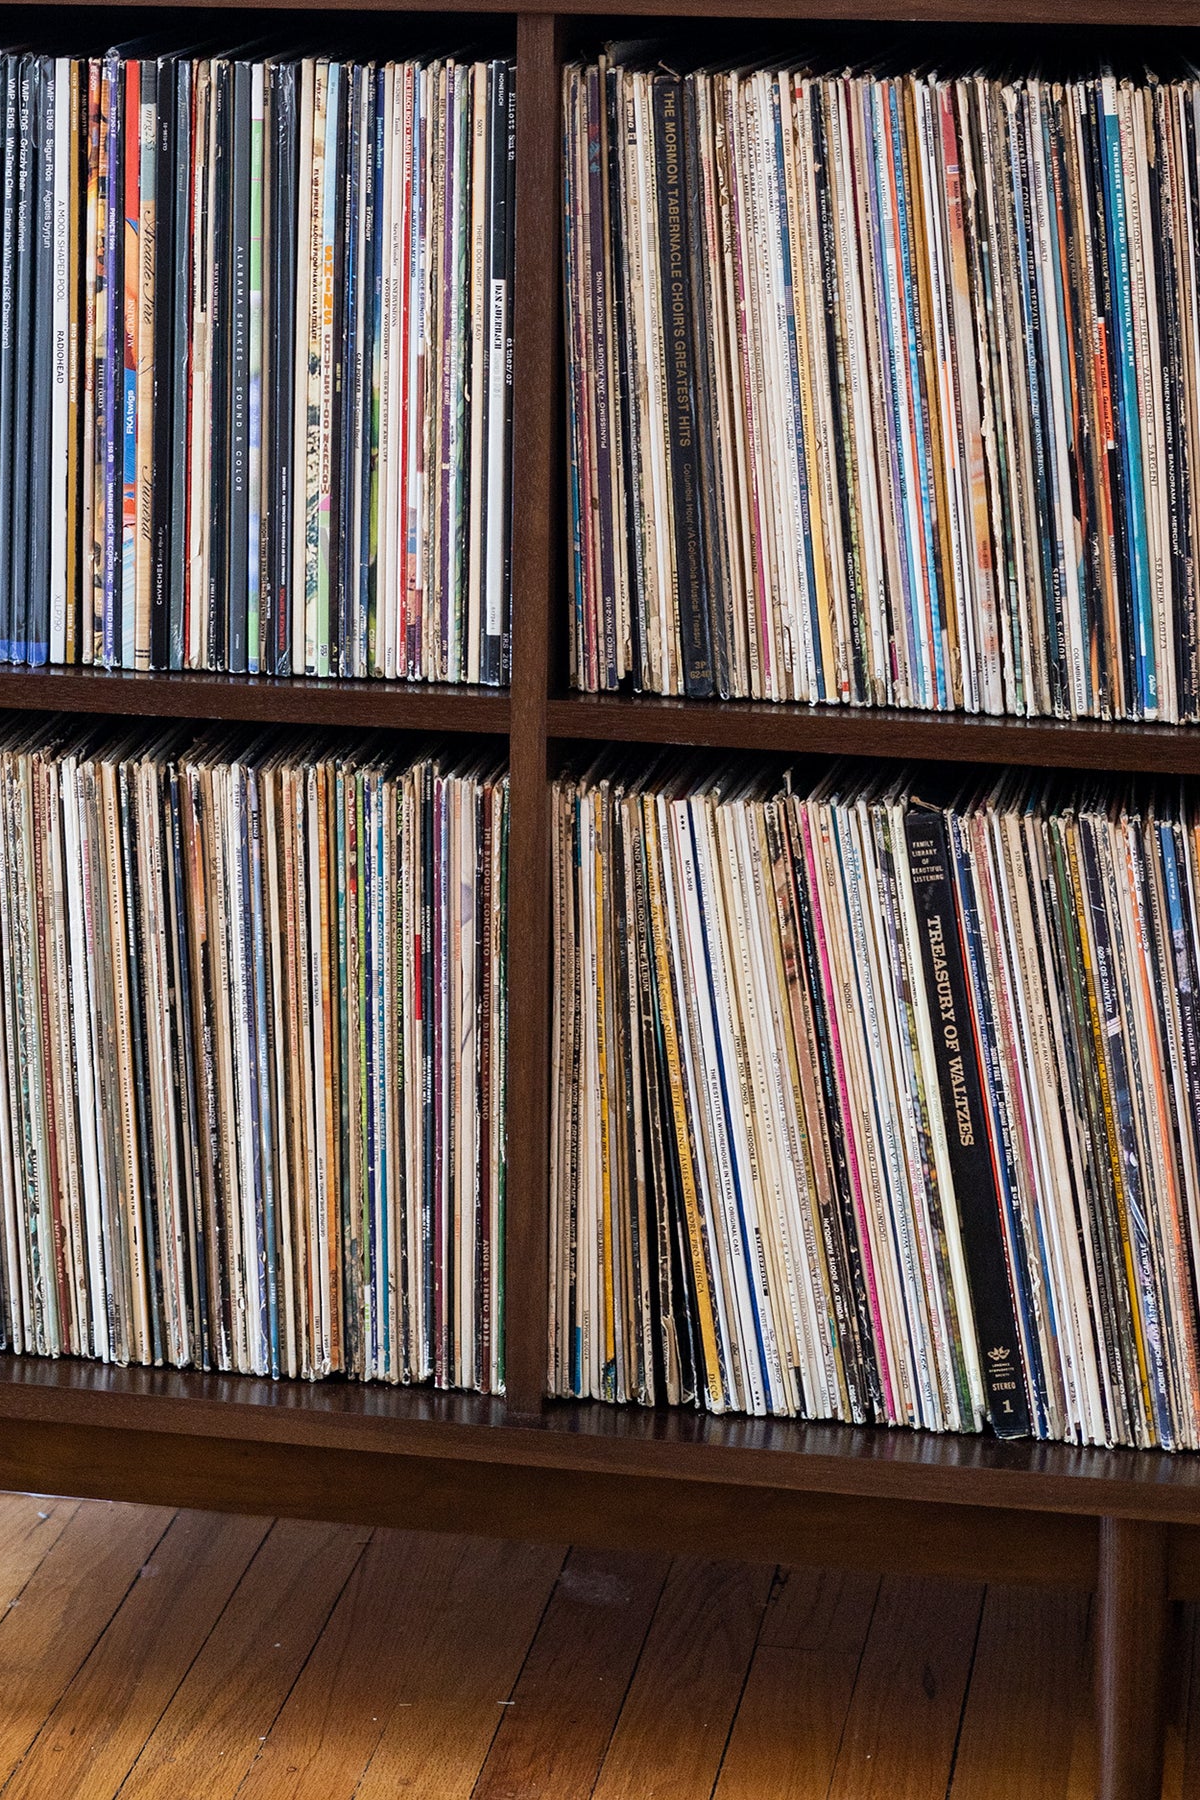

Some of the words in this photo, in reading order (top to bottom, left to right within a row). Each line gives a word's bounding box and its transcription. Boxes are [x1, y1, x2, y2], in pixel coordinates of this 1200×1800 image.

[664, 91, 675, 117] THE
[44, 139, 53, 161] Sigur
[665, 122, 678, 184] MORMON
[44, 222, 52, 248] byrjun
[667, 190, 681, 277] TABERNACLE
[1113, 142, 1122, 189] TENNESSEE
[1122, 286, 1131, 328] SPIRITUAL
[1127, 355, 1134, 366] ME
[671, 283, 685, 337] CHOIR'S
[494, 304, 502, 349] AUERBACH
[675, 341, 690, 410] GREATEST
[679, 417, 691, 446] HITS
[912, 866, 944, 874] BEAUTIFUL
[913, 874, 944, 883] LISTENING
[927, 916, 954, 1020] TREASURY
[483, 1022, 489, 1032] DI
[943, 1026, 960, 1052] OF
[714, 1100, 722, 1120] LITTLE
[948, 1058, 974, 1146] WALTZES
[717, 1122, 726, 1168] WHOREHOUSE
[724, 1179, 732, 1200] TEXAS
[728, 1206, 736, 1237] ORIGINAL
